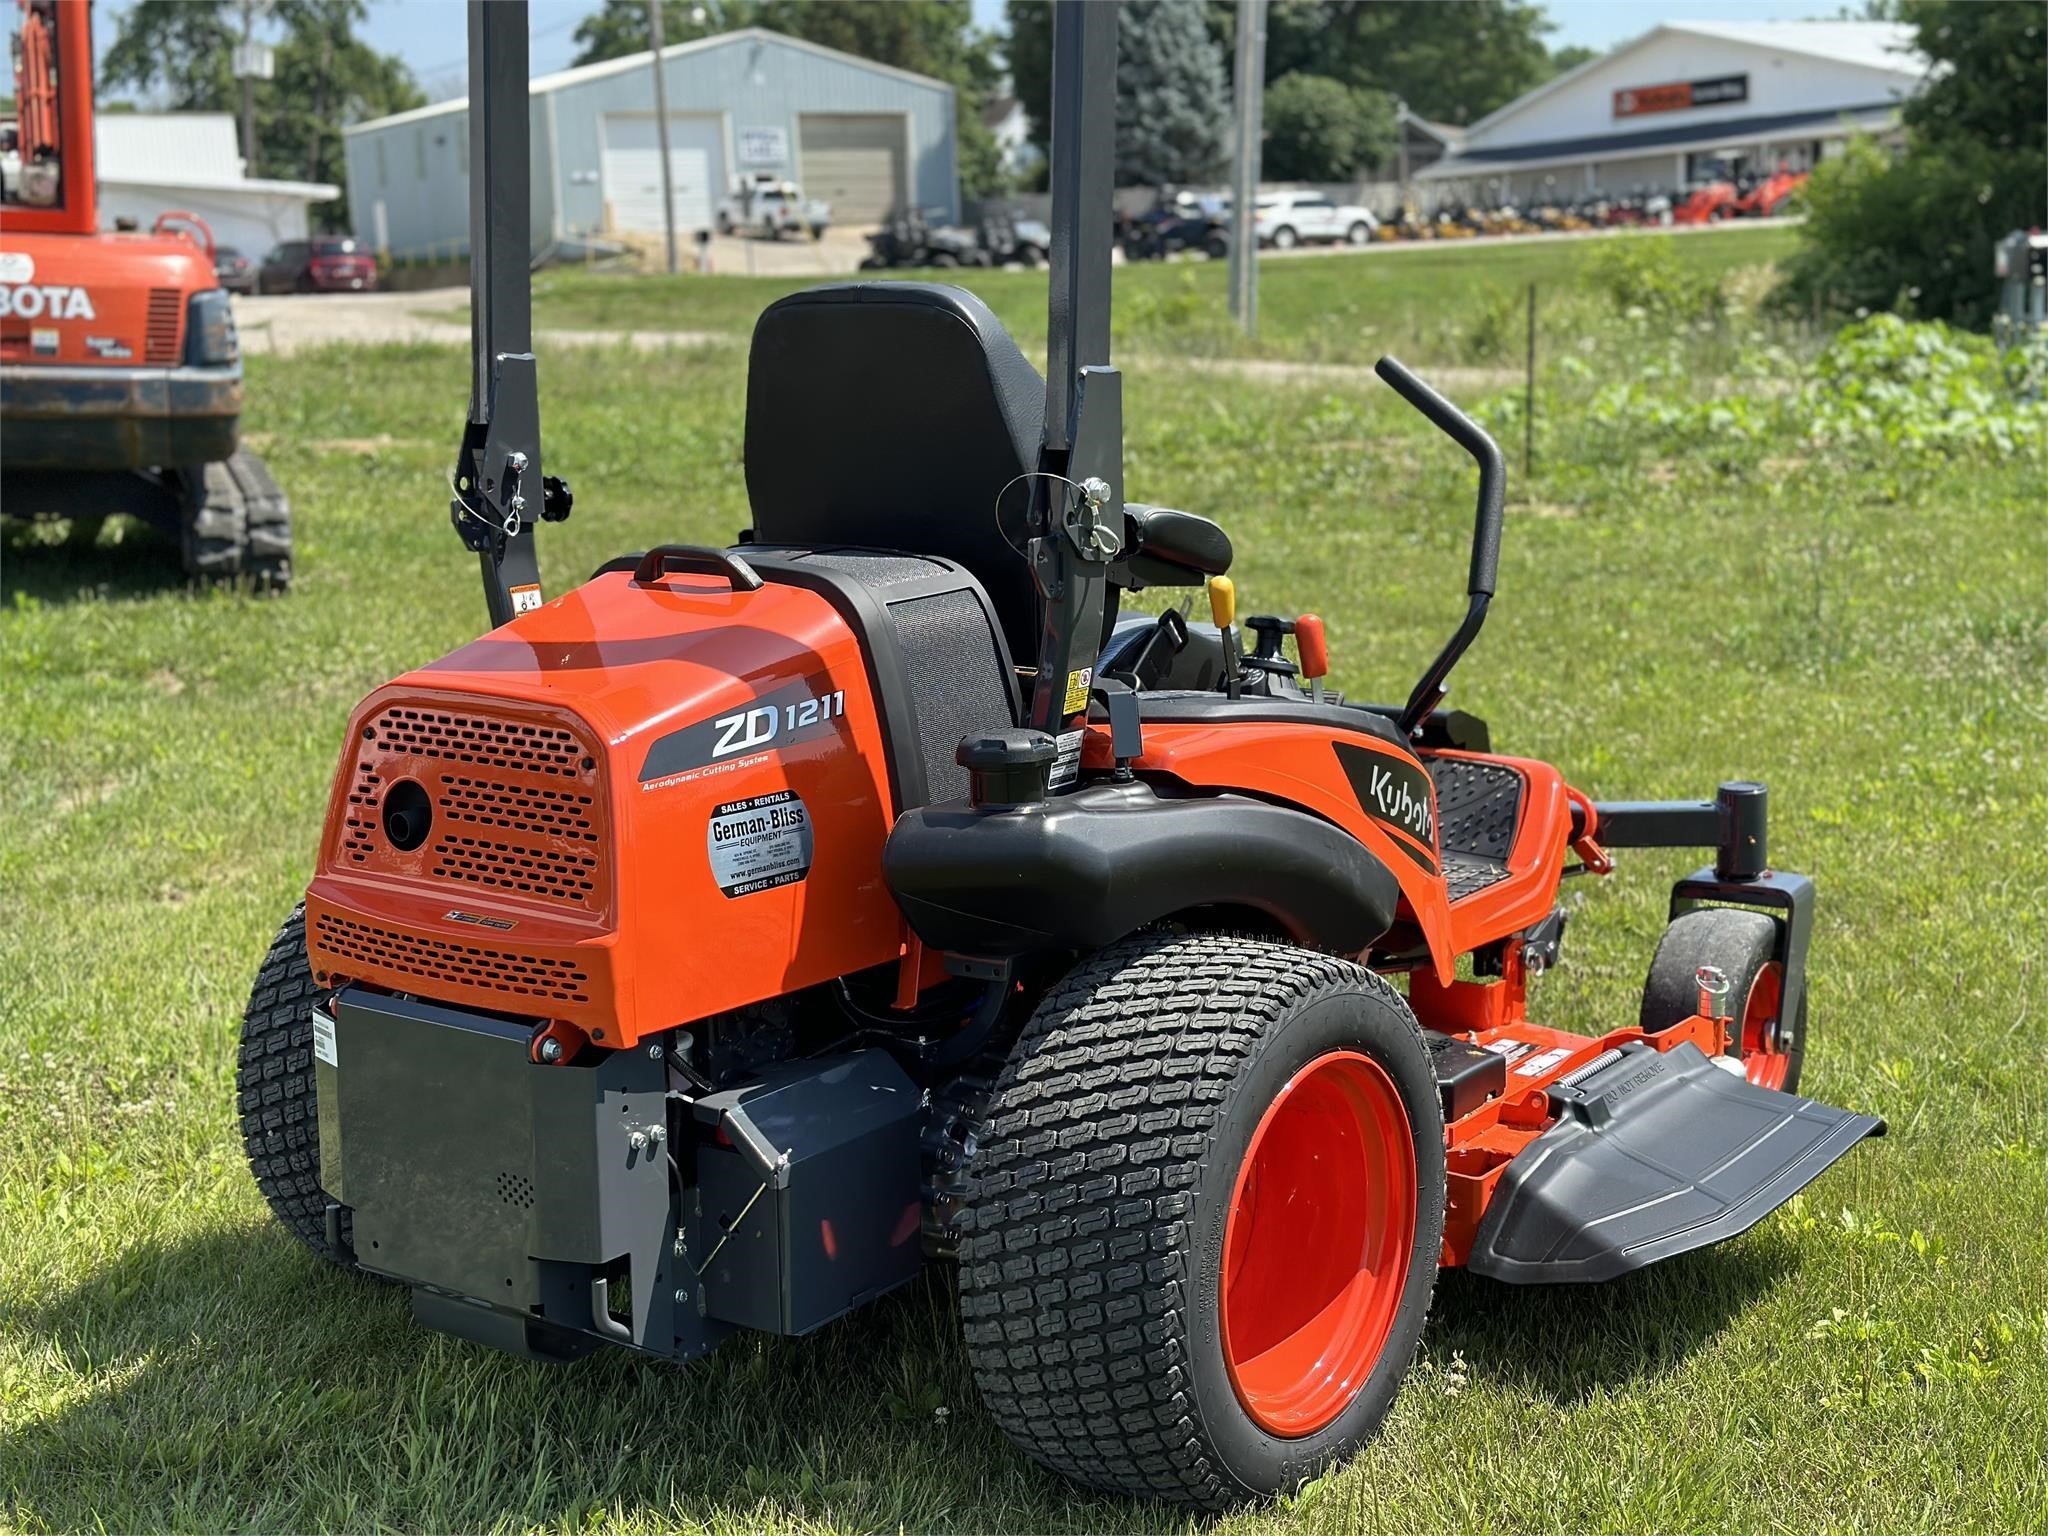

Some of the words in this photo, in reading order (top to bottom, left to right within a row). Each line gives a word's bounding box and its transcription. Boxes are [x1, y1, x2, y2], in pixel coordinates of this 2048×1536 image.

[712, 705, 779, 758] ZD
[786, 690, 845, 731] 1211
[642, 771, 700, 792] Aerodynamic
[702, 762, 736, 777] Cutting
[737, 755, 769, 769] System
[721, 801, 748, 814] SALES
[754, 792, 790, 807] RENTALS
[1370, 765, 1434, 844] Kubota
[713, 807, 804, 842] German-Bliss
[740, 830, 782, 847] EQUIPMENT
[730, 857, 800, 879] www.germanbliss.com
[734, 880, 768, 895] SERVICE
[774, 871, 800, 885] PARTS
[1617, 1080, 1635, 1096] NOT
[1632, 1061, 1665, 1086] REMOVE
